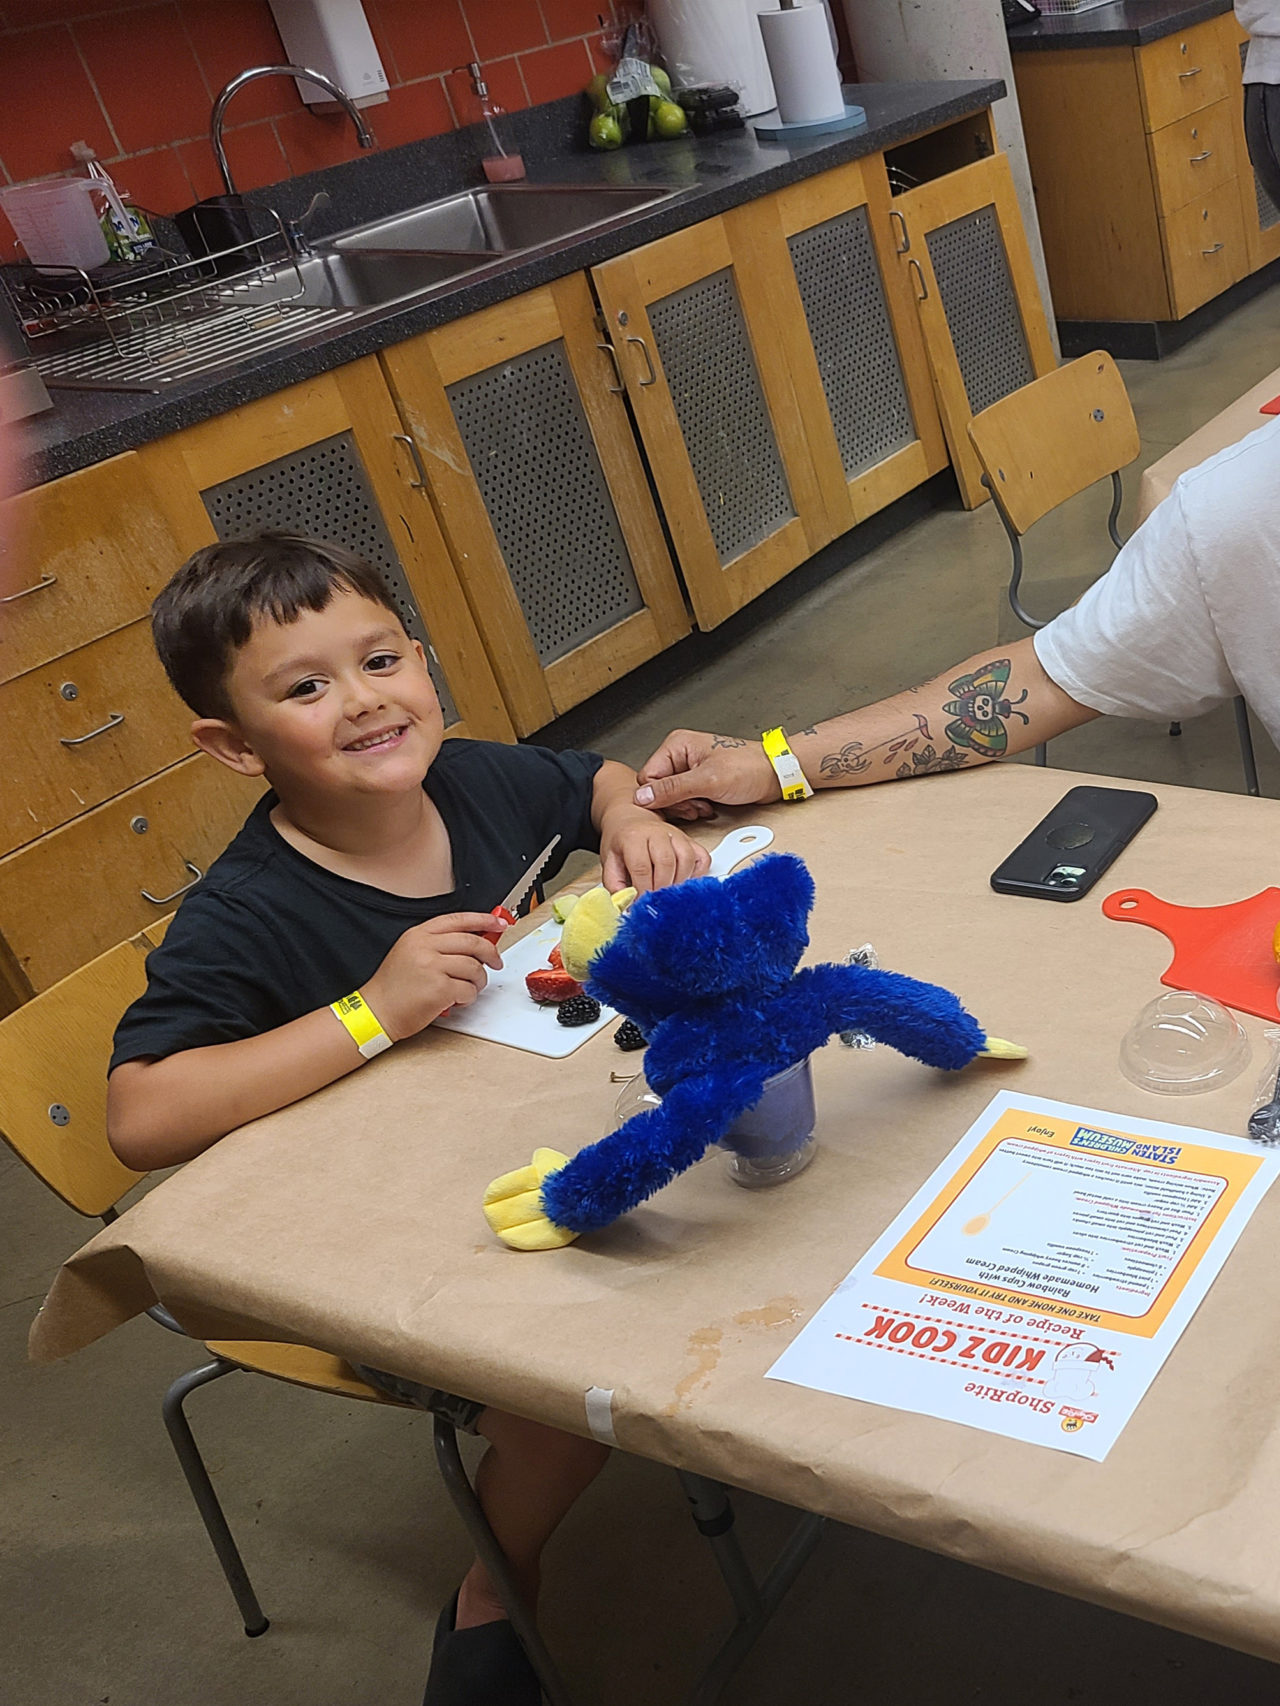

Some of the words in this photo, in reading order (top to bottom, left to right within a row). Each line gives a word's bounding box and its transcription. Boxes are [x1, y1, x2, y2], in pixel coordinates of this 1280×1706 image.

[1076, 1128, 1137, 1149] MUSEUM
[1130, 1148, 1178, 1165] STATEN
[1135, 1143, 1182, 1156] ISLAND
[965, 1257, 997, 1271] Cream
[978, 1271, 1001, 1281] with
[995, 1264, 1041, 1281] Whipped
[928, 1277, 980, 1295] YOURSELF!
[1001, 1276, 1026, 1288] Cups
[1026, 1281, 1071, 1298] Rainbow
[1041, 1273, 1100, 1294] Homemade
[978, 1288, 991, 1298] IT
[987, 1291, 1008, 1302] TRY
[1007, 1295, 1030, 1306] AND
[918, 1293, 971, 1315] Week!
[1026, 1299, 1057, 1313] HOME
[1054, 1306, 1077, 1317] ONE
[974, 1305, 1003, 1321] the
[1001, 1313, 1024, 1324] of
[1075, 1310, 1101, 1323] TAKE
[863, 1314, 958, 1353] COOK
[1025, 1318, 1086, 1340] Recipe
[957, 1335, 1046, 1372] KIDZ
[963, 1382, 1056, 1414] ShopRite
